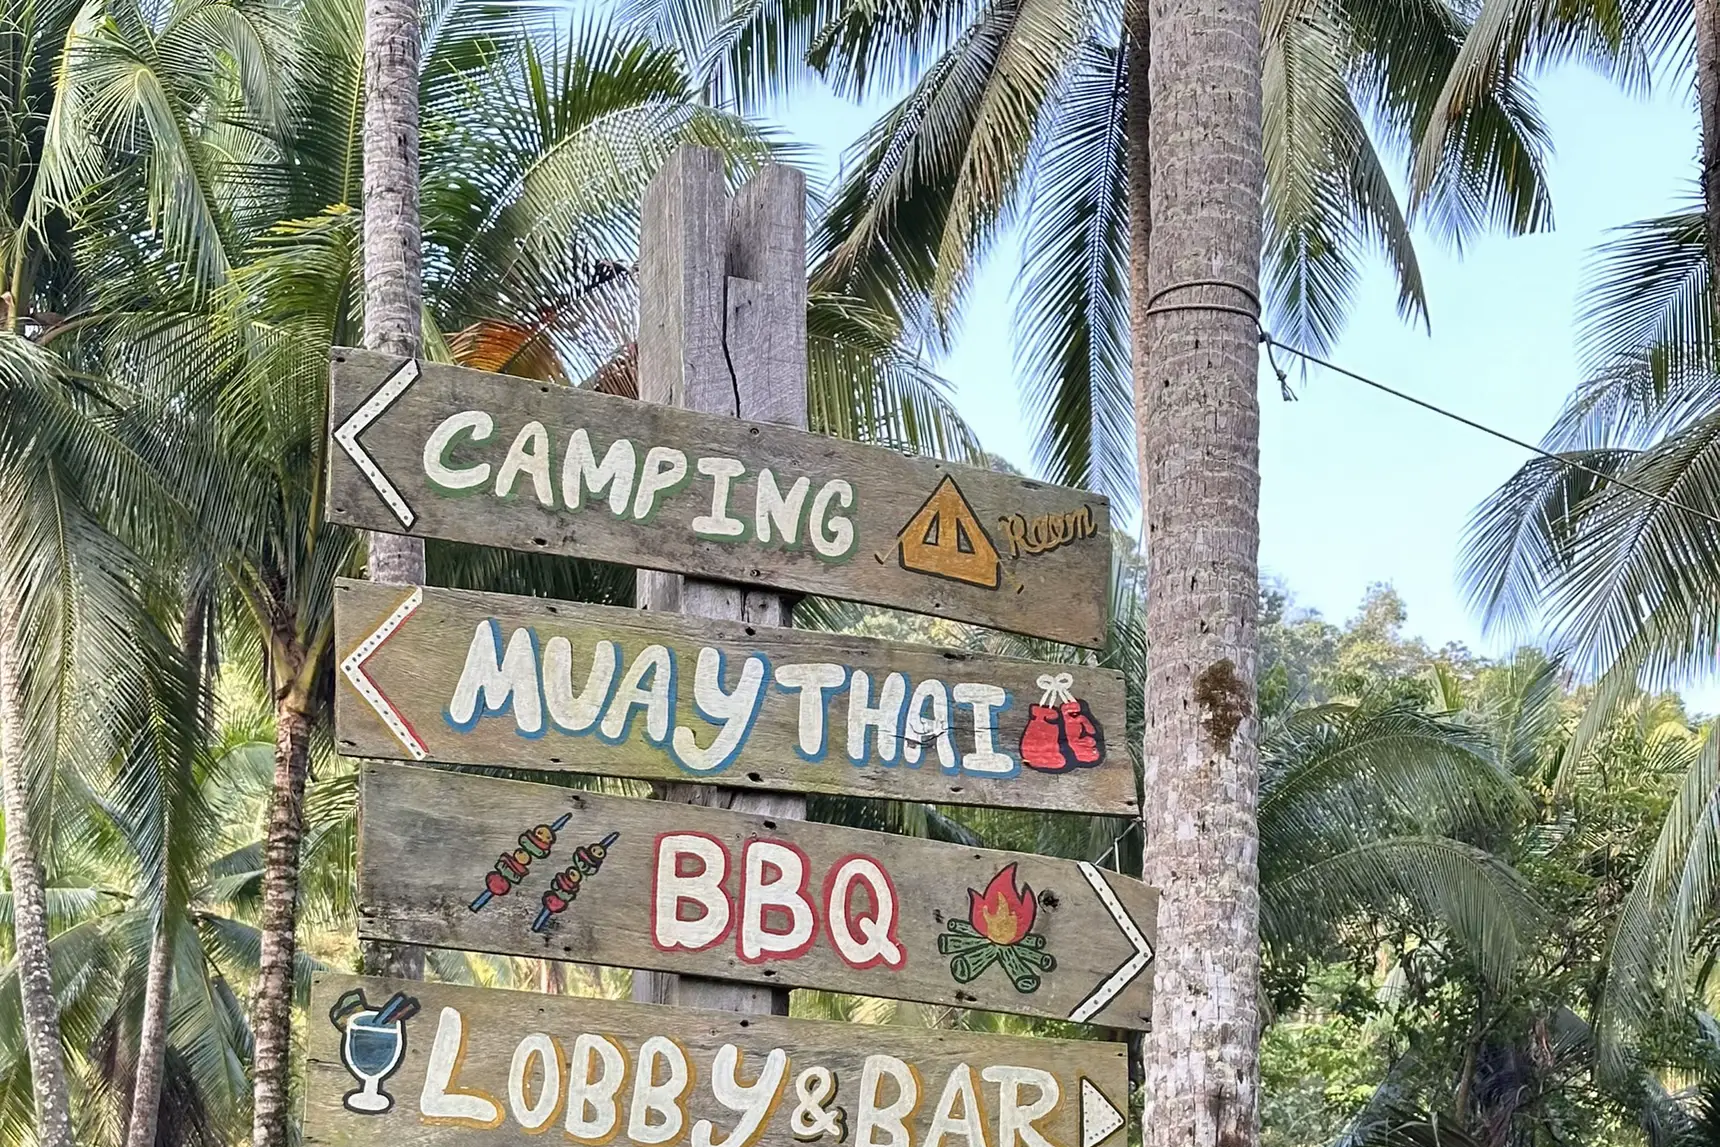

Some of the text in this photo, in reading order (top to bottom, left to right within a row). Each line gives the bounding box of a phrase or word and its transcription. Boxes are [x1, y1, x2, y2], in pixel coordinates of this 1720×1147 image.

[423, 409, 859, 562] CAMPING
[998, 504, 1097, 560] Room
[651, 830, 907, 971] BBQ
